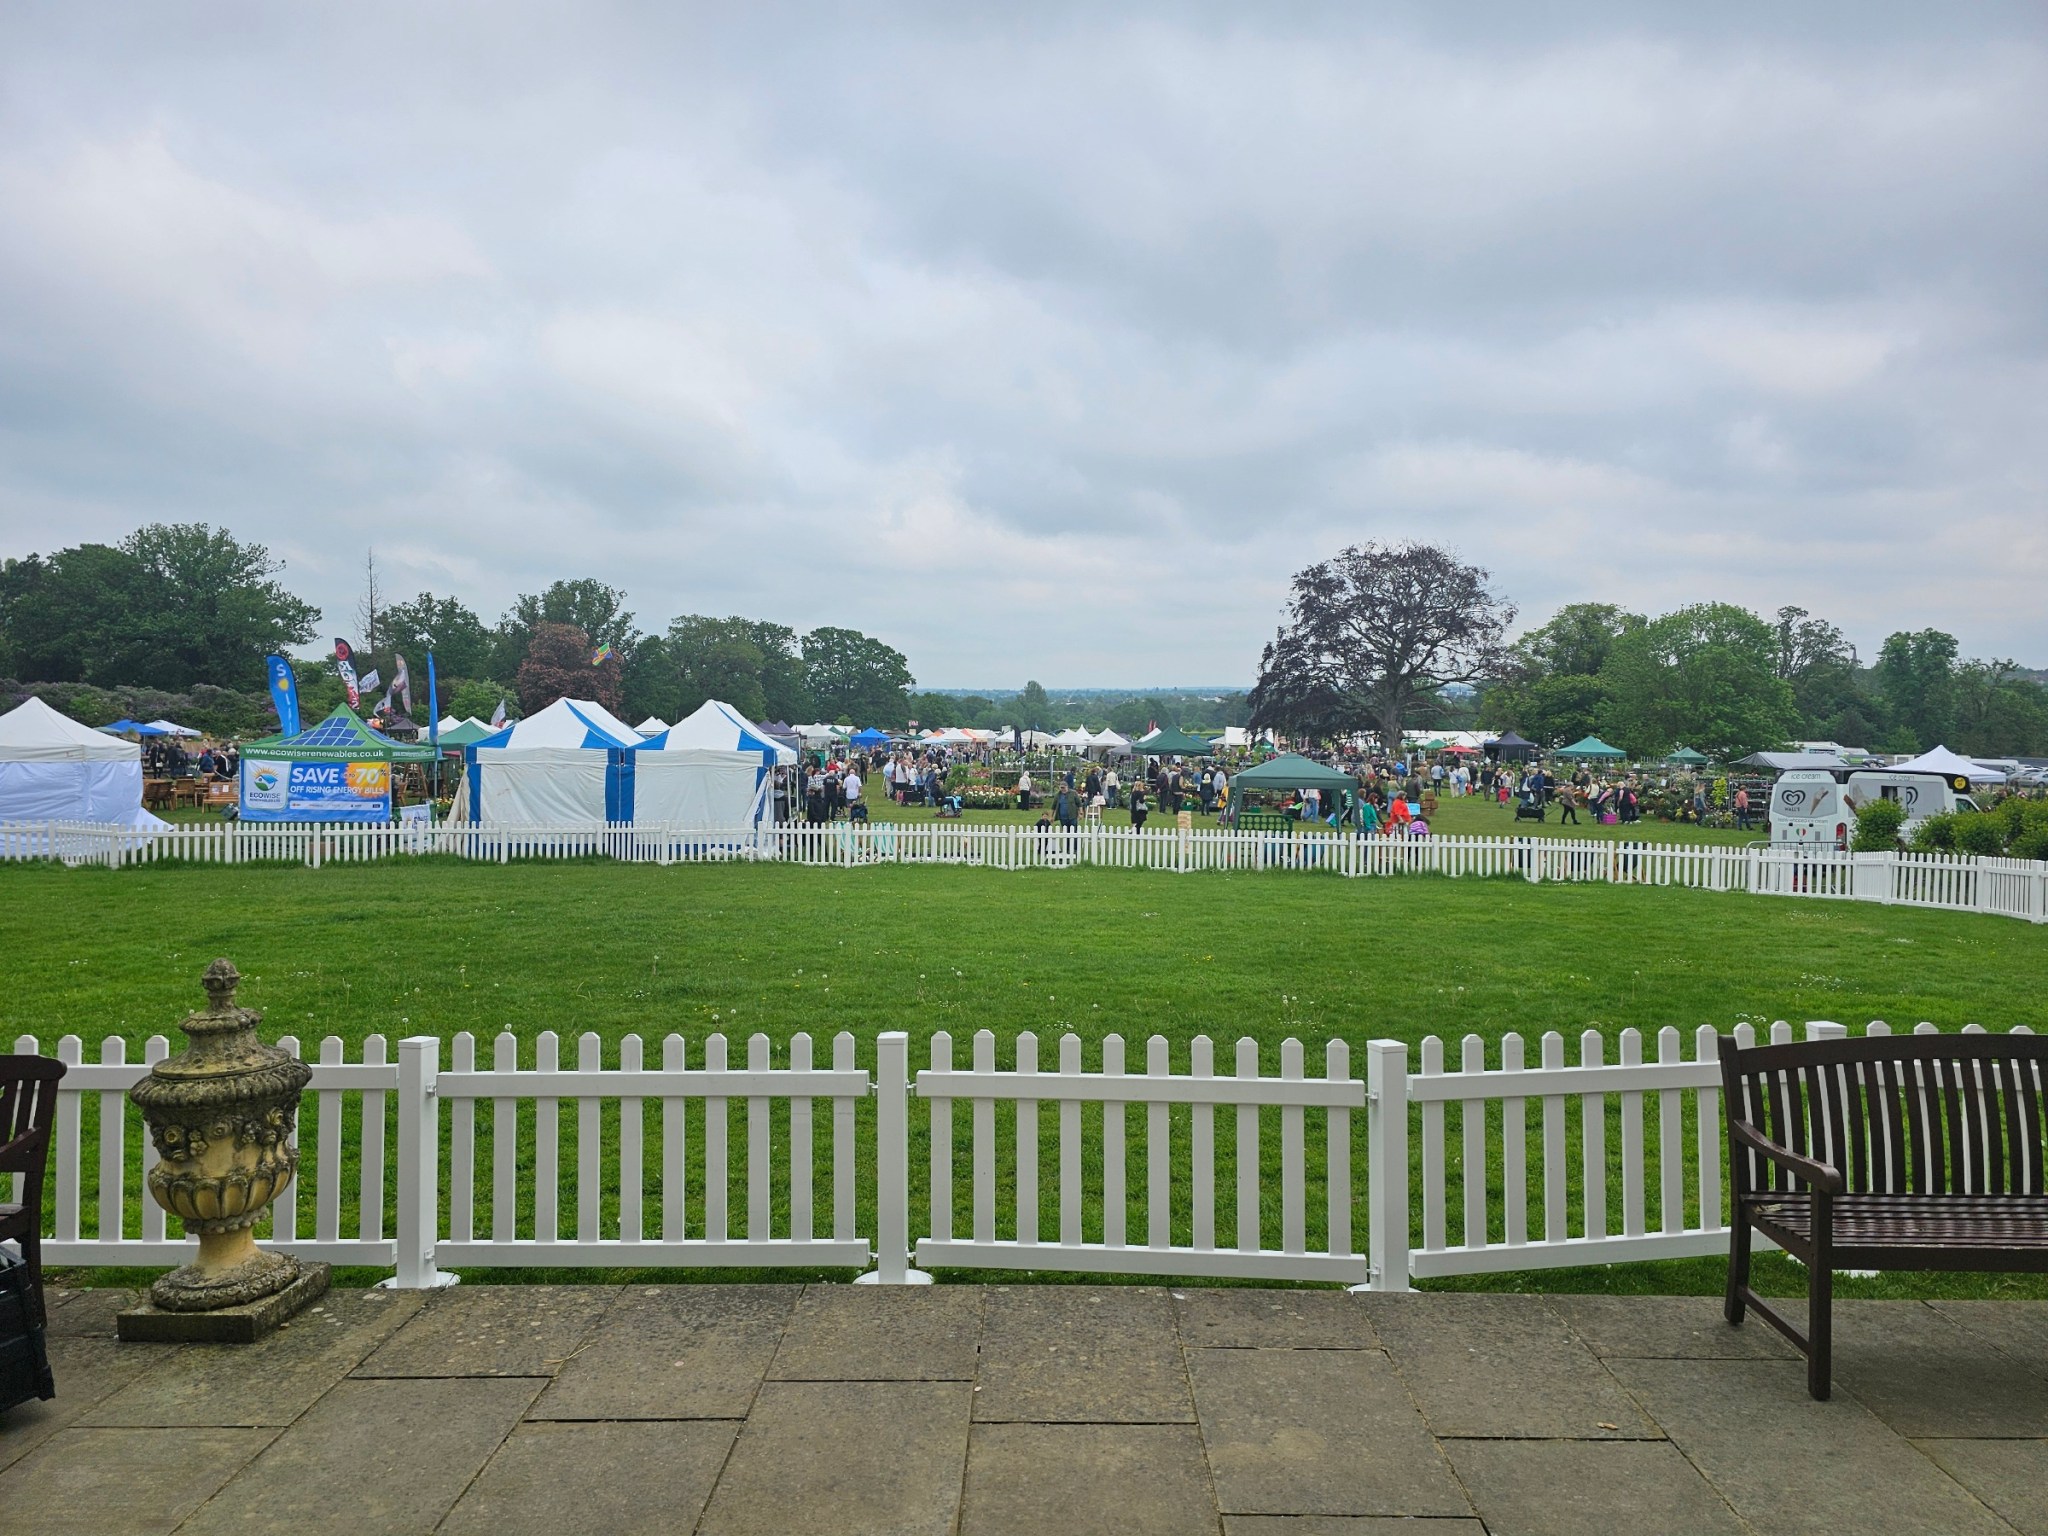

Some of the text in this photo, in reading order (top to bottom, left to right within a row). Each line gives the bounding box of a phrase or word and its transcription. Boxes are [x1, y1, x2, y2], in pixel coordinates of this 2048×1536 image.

[245, 747, 384, 758] www.ecowiserenewables.co.uk
[291, 767, 340, 784] SAVE
[249, 791, 281, 799] ECOWISE
[290, 785, 385, 795] OFF RISING ENERGY BILLS
